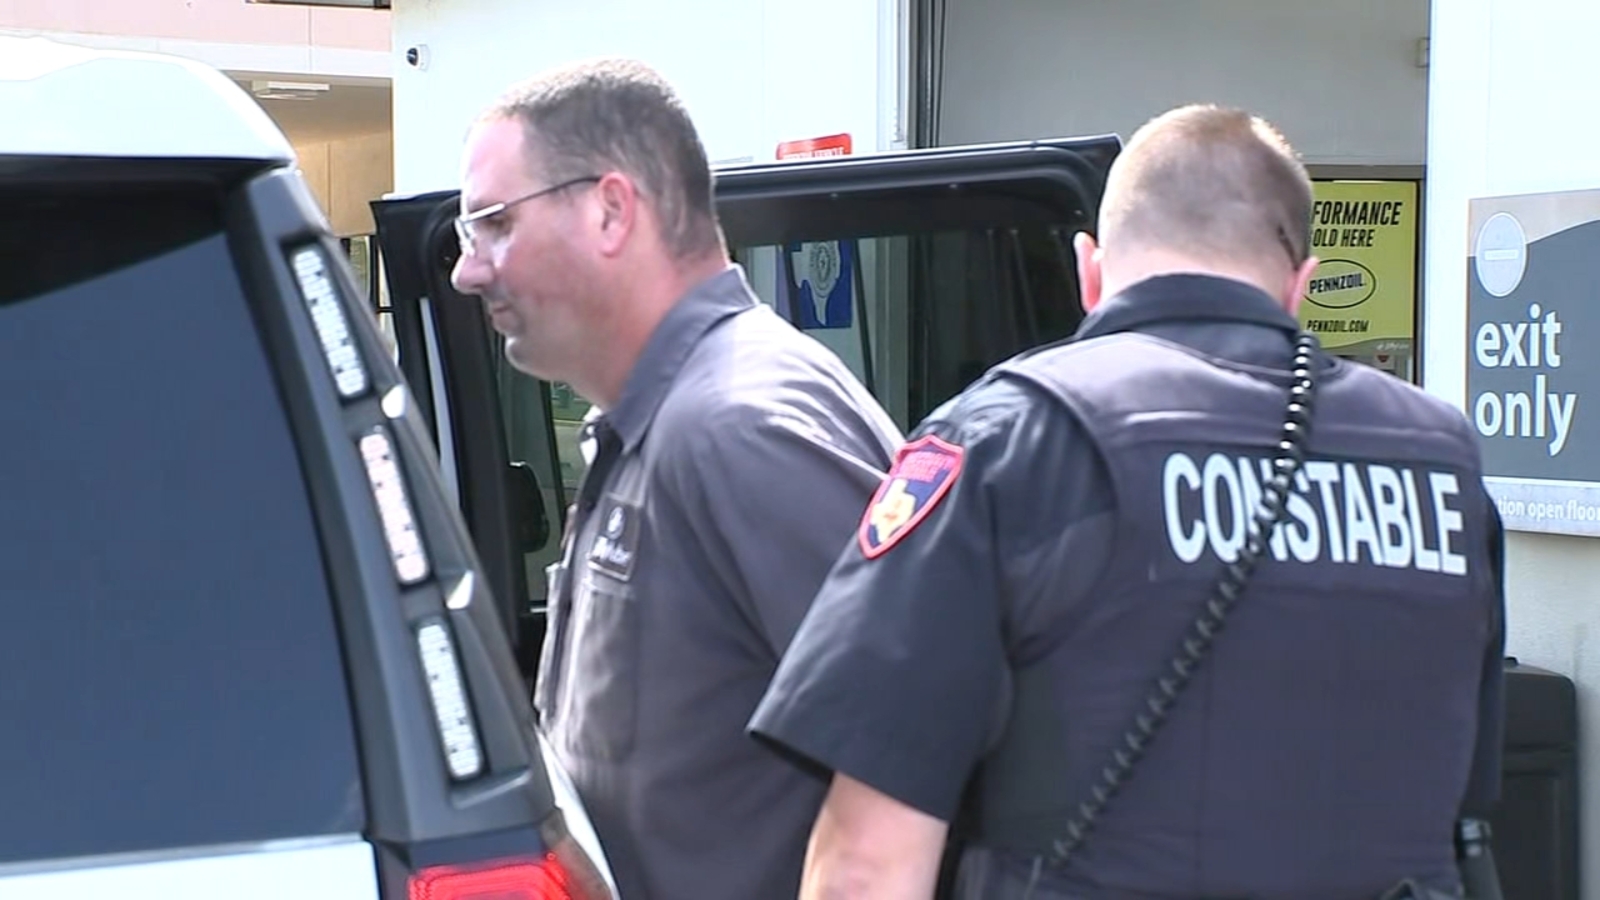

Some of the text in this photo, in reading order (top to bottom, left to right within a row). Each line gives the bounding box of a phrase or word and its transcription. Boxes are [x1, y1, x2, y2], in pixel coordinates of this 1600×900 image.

[1311, 201, 1403, 225] FORMANCE
[1309, 228, 1375, 248] OLD HERE
[1306, 320, 1369, 332] PENNZOIL.COM
[1475, 303, 1561, 368] exit
[1475, 374, 1577, 457] only
[1163, 452, 1468, 576] CONSTABLE
[1497, 496, 1526, 516] tion
[1527, 501, 1564, 522] open
